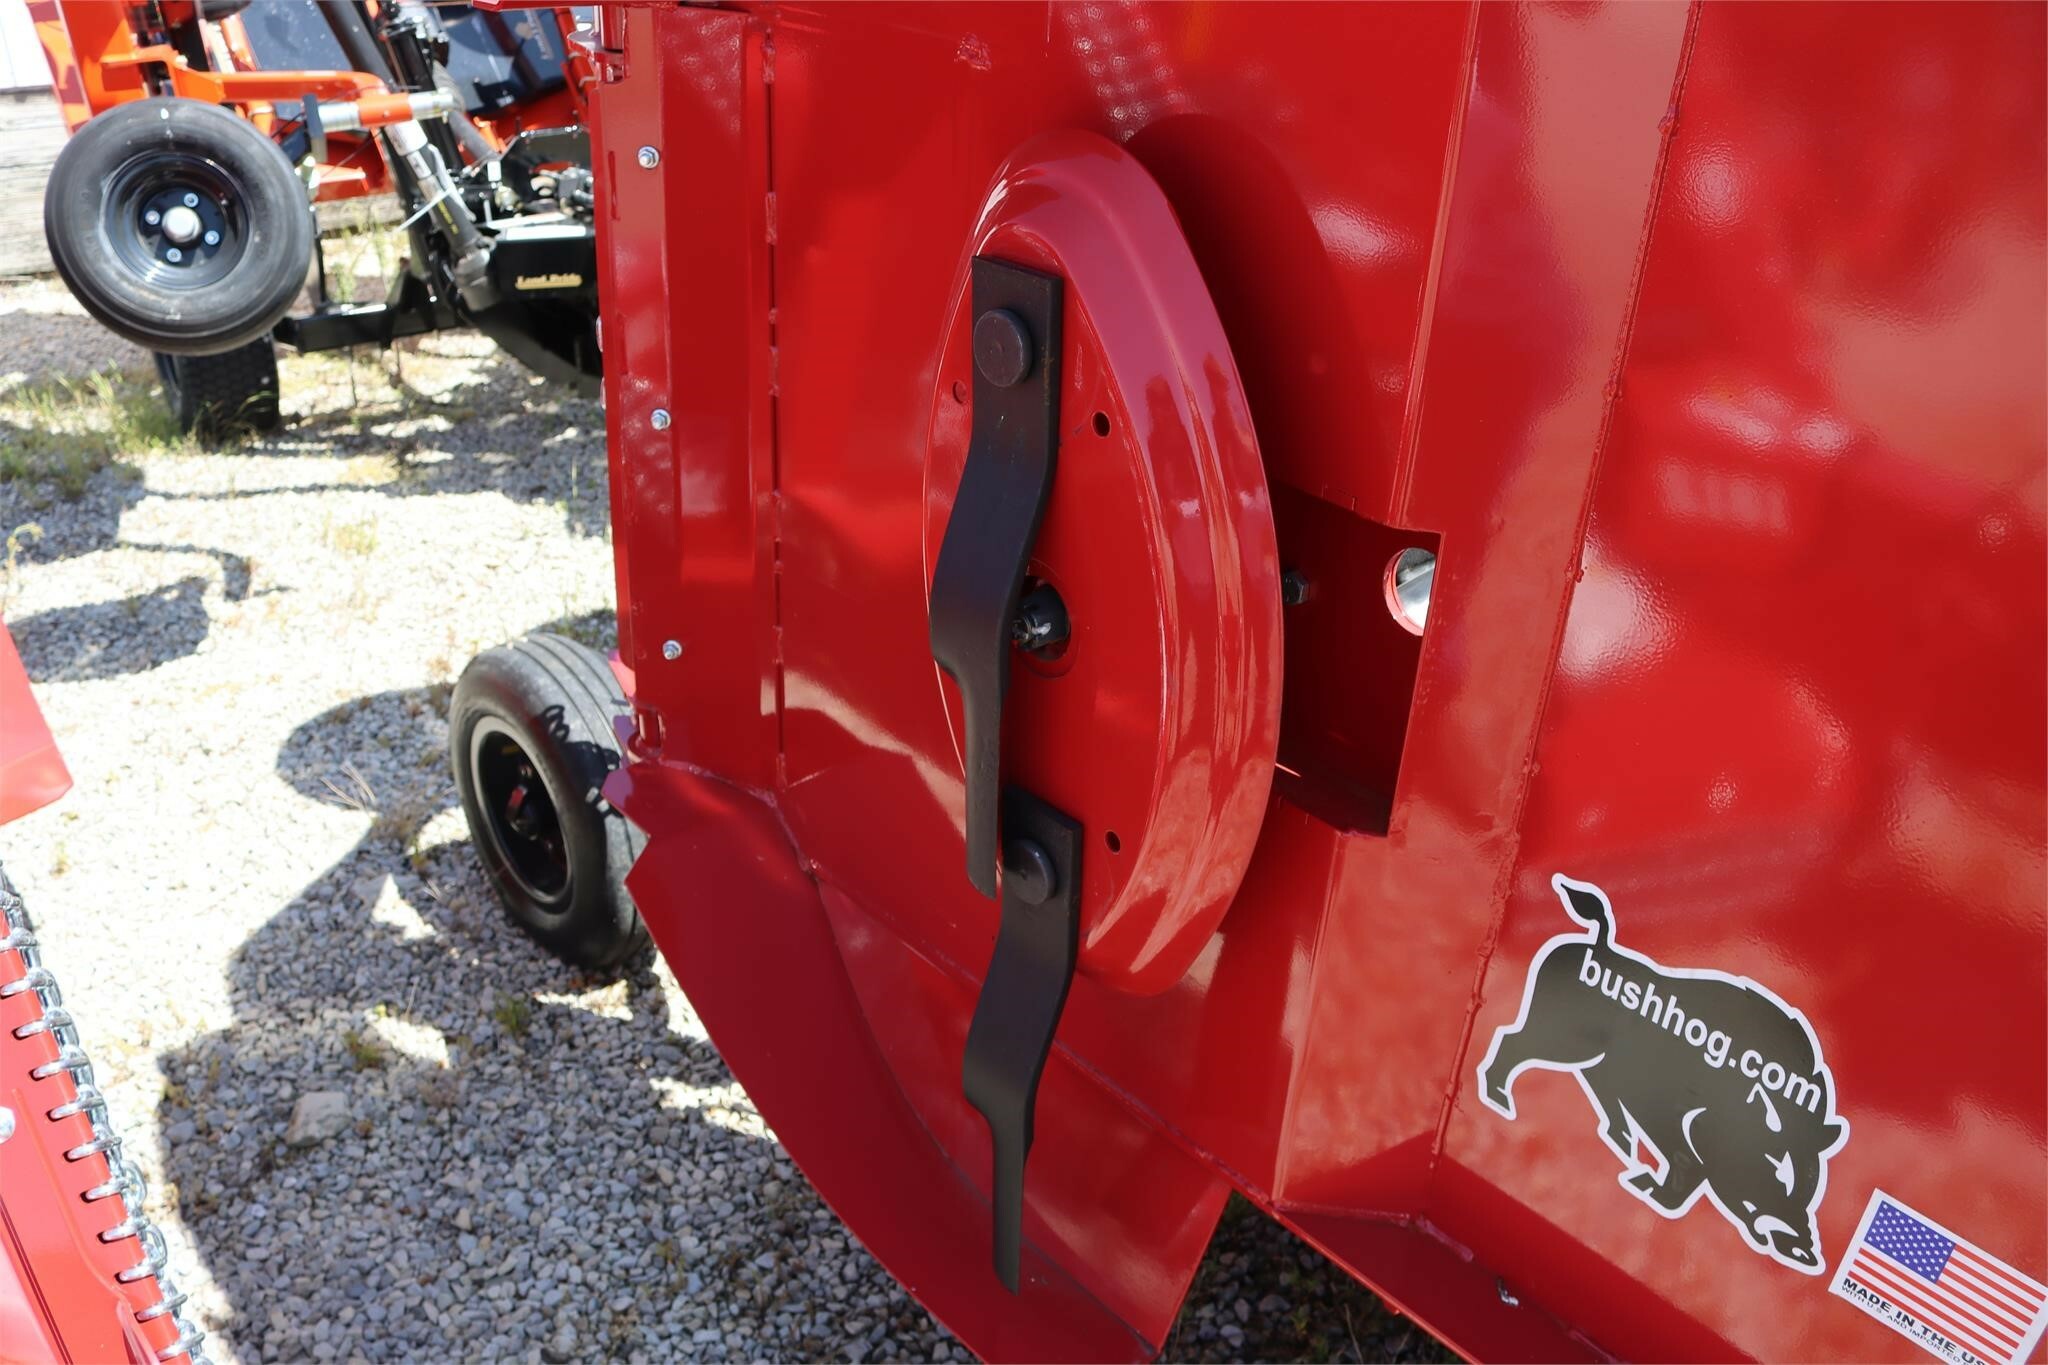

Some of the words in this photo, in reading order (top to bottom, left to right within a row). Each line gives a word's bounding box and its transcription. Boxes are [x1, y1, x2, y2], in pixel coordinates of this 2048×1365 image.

[1579, 948, 1822, 1112] bushhog.com
[1843, 1278, 1892, 1313] MADE
[1896, 1311, 1915, 1327] IN
[1921, 1325, 1957, 1353] THE
[1887, 1315, 1907, 1329] AND
[1909, 1329, 1960, 1362] IMPORTED
